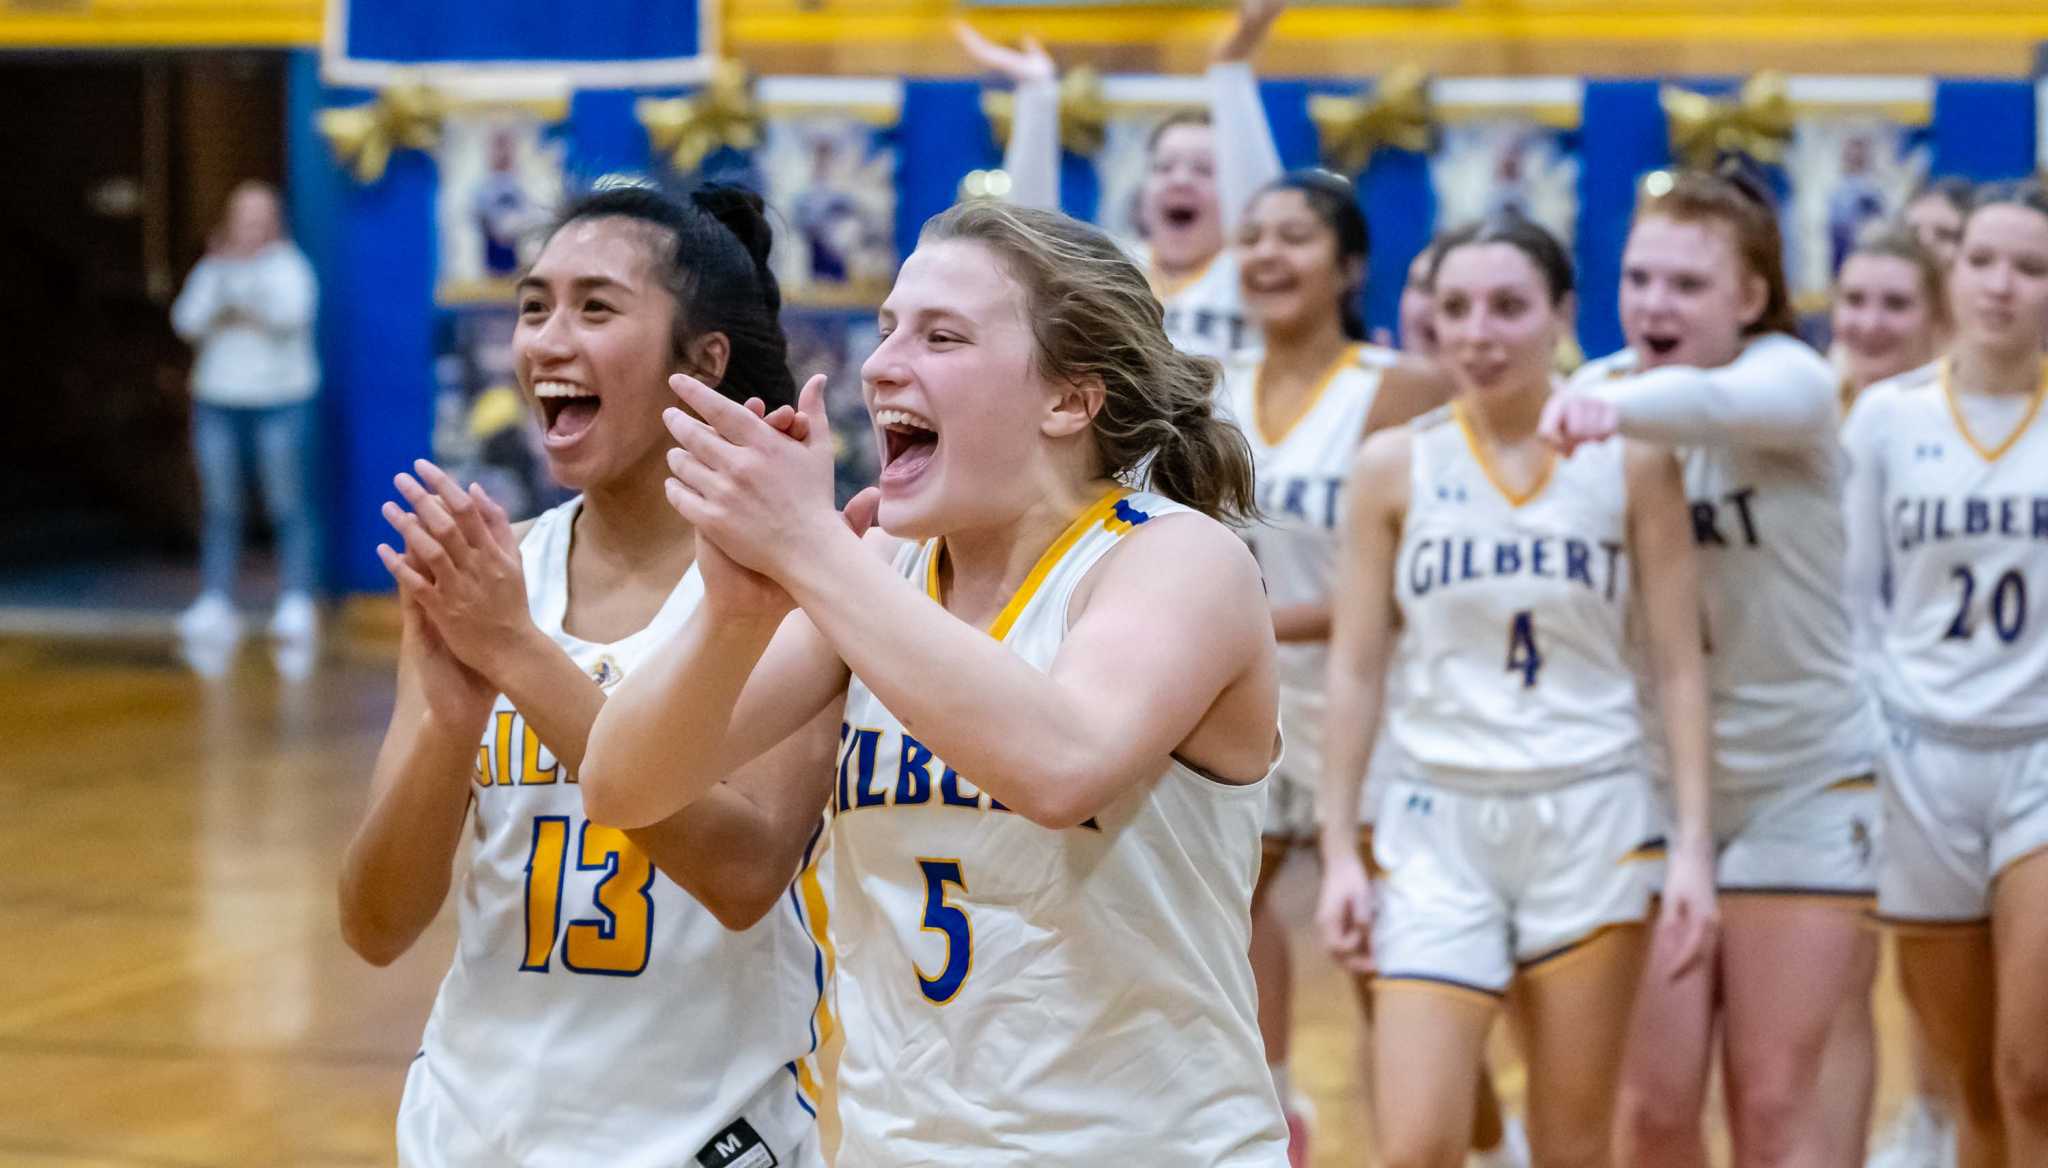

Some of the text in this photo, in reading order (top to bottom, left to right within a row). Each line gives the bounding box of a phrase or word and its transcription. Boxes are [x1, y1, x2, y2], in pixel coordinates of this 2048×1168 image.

[1410, 536, 1625, 599] GILBERT
[1942, 563, 2027, 643] 20
[1506, 609, 1543, 689] 4
[518, 814, 656, 977] 13
[911, 856, 974, 1006] 5
[714, 1132, 742, 1158] M
